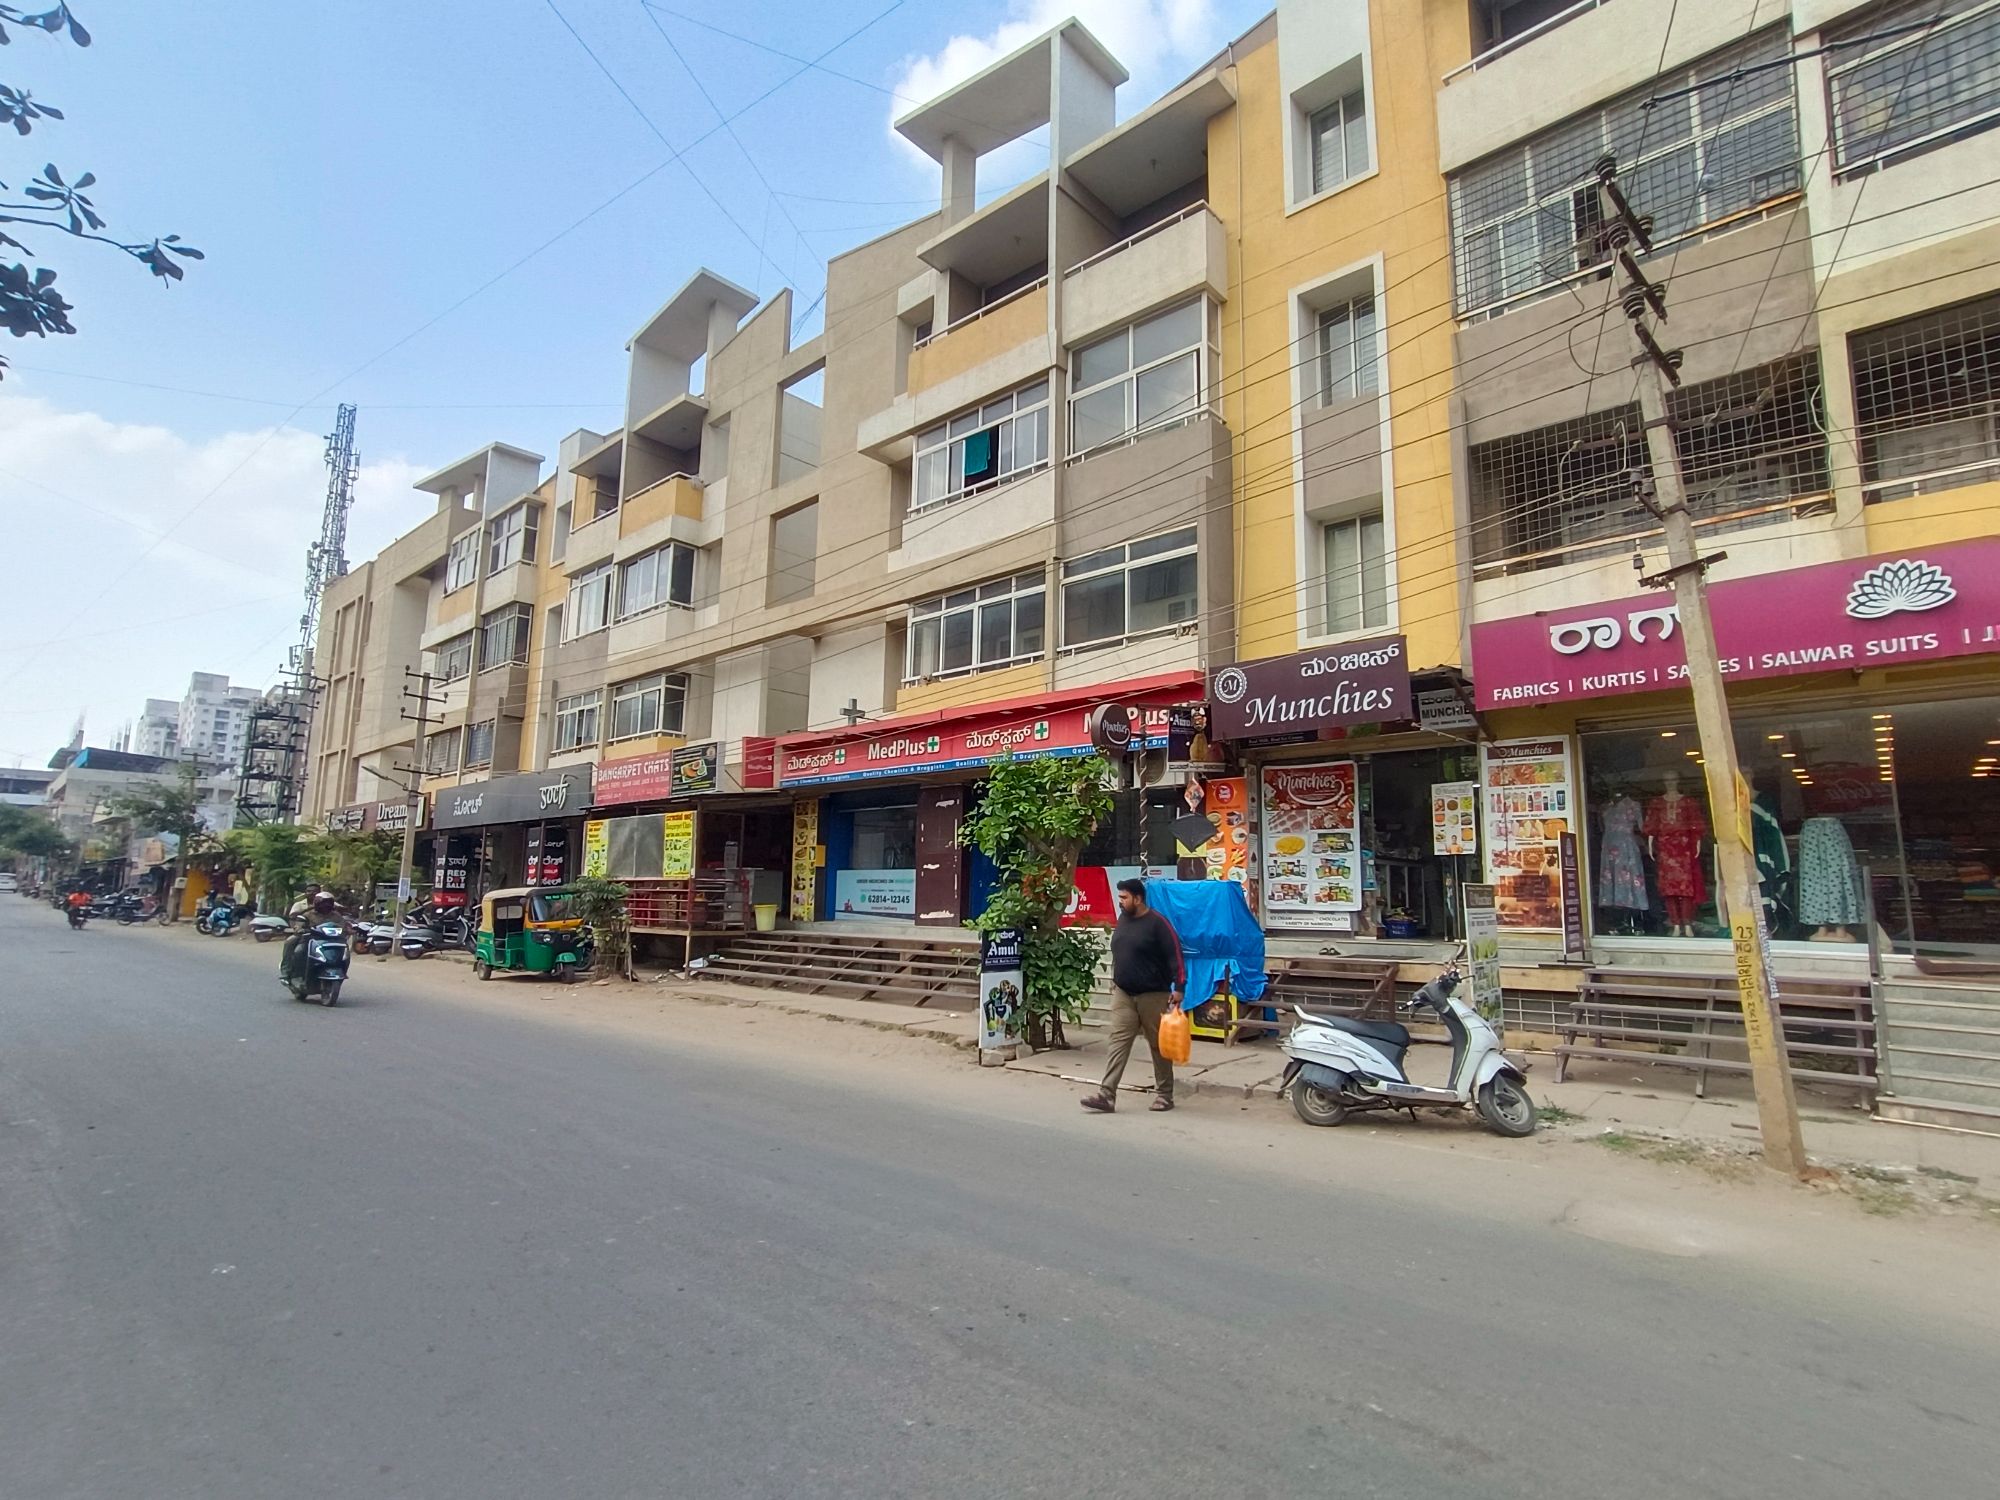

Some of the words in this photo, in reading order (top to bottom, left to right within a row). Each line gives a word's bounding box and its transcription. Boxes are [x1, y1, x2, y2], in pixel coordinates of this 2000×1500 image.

[1493, 681, 1560, 702] FABRICS
[1582, 670, 1646, 691] KURTIS
[1667, 657, 1740, 680] SAES
[1762, 644, 1854, 668] SALWAR
[1866, 633, 1938, 656] SUITS
[1244, 680, 1394, 728] Munchies
[867, 740, 926, 760] MedPlus
[1508, 746, 1552, 758] Munchies
[598, 763, 642, 782] BANGARPET
[644, 758, 670, 775] CHATS
[1278, 771, 1341, 796] Munchies
[868, 895, 910, 903] 62814-12345
[1736, 926, 1752, 940] 23
[988, 942, 1018, 957] Amul
